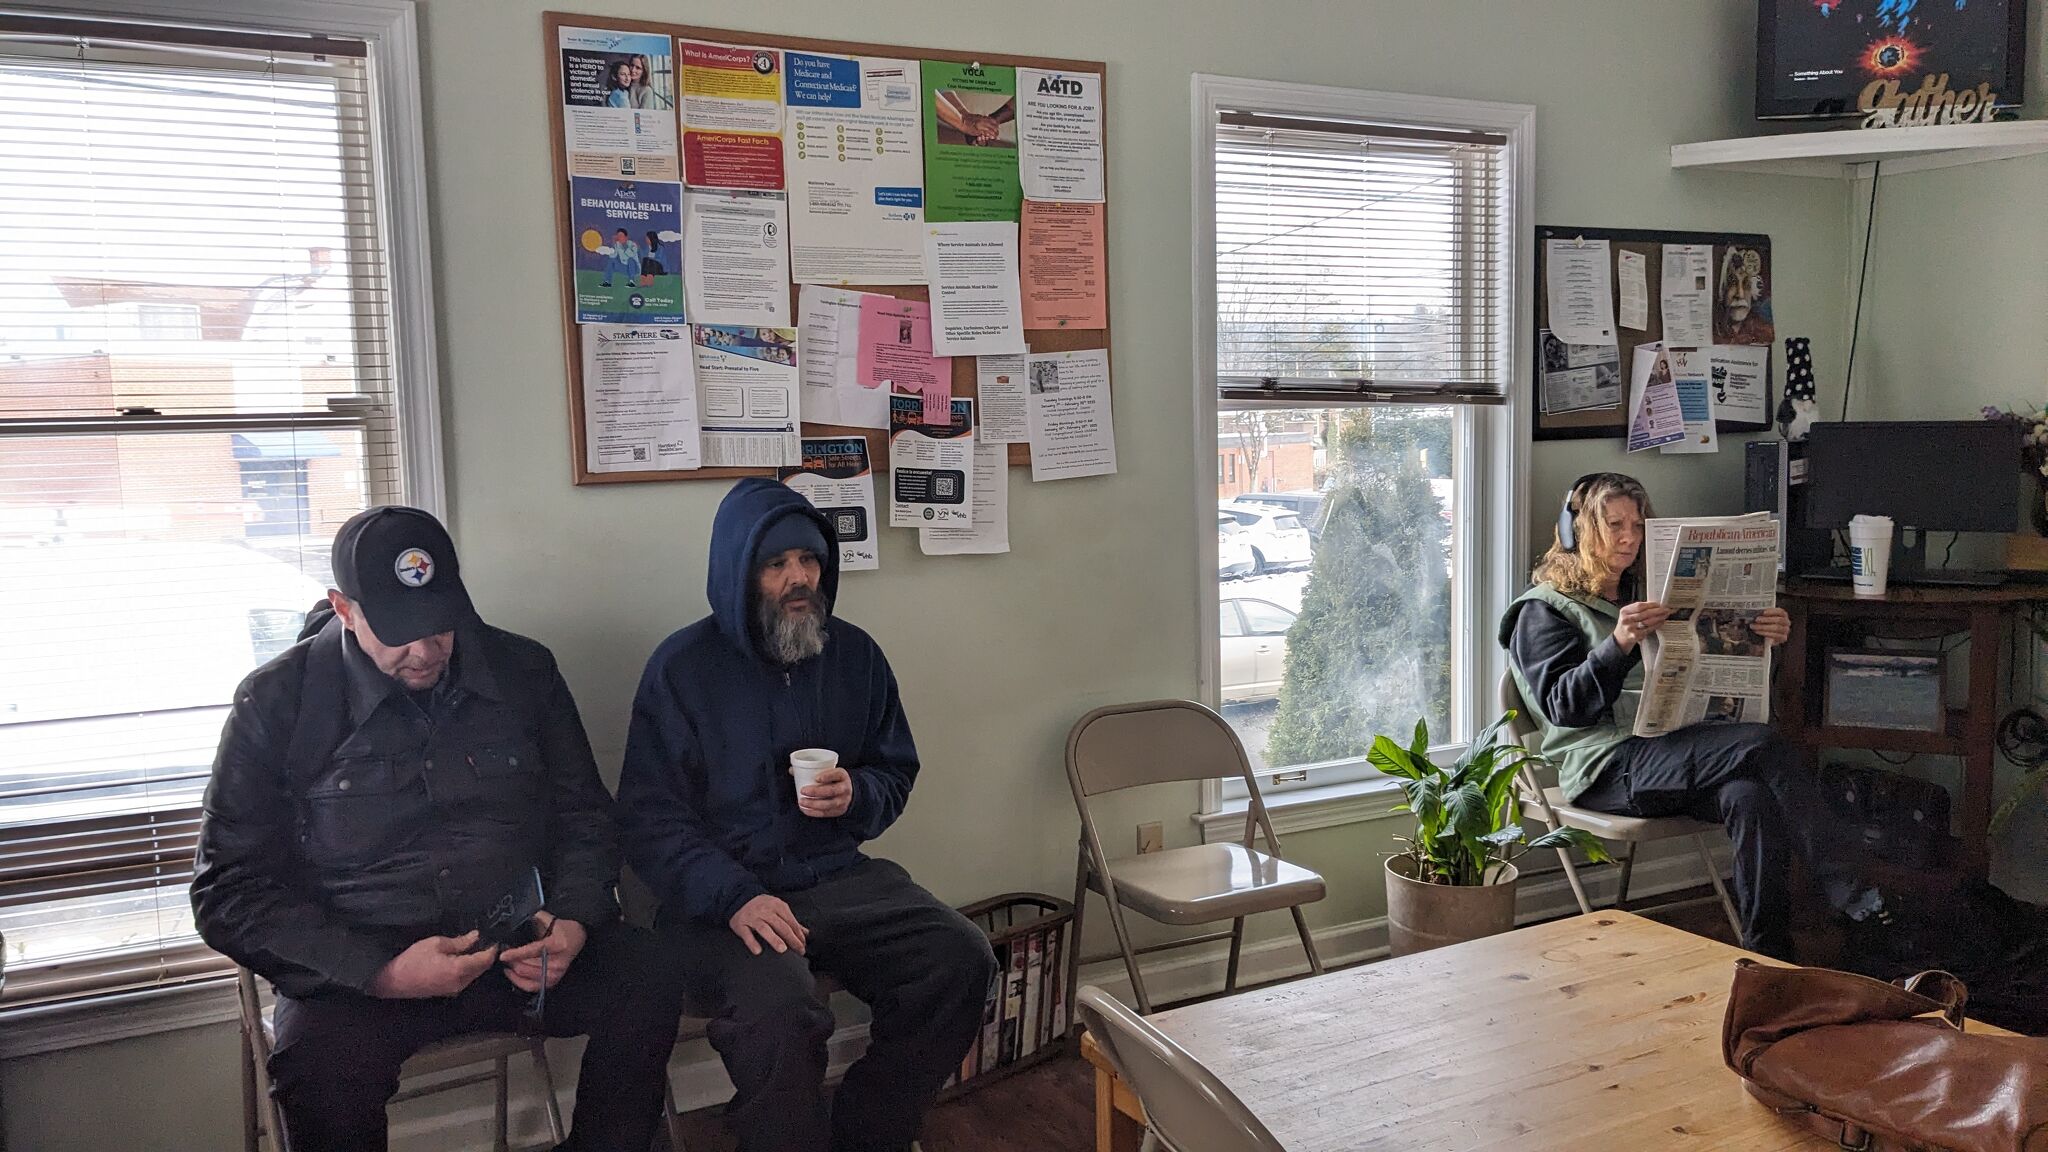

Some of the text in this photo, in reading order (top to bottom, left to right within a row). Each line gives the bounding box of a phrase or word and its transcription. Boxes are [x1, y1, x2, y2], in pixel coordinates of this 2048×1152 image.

[684, 49, 701, 57] What
[708, 52, 751, 63] AmeriCorps?
[794, 57, 831, 69] Do you have
[794, 68, 832, 80] Medicare and
[962, 68, 985, 77] VOCA
[794, 80, 829, 90] Connecticut
[1037, 77, 1083, 96] A4TD
[795, 91, 806, 99] We
[817, 92, 832, 103] help!
[696, 134, 770, 145] AmeriCorps Fast Facts
[614, 188, 637, 199] Apex
[581, 198, 673, 213] BEHAVIORAL HEALTH
[606, 209, 649, 220] SERVICES
[613, 332, 635, 340] START
[802, 443, 864, 454] RINGTON
